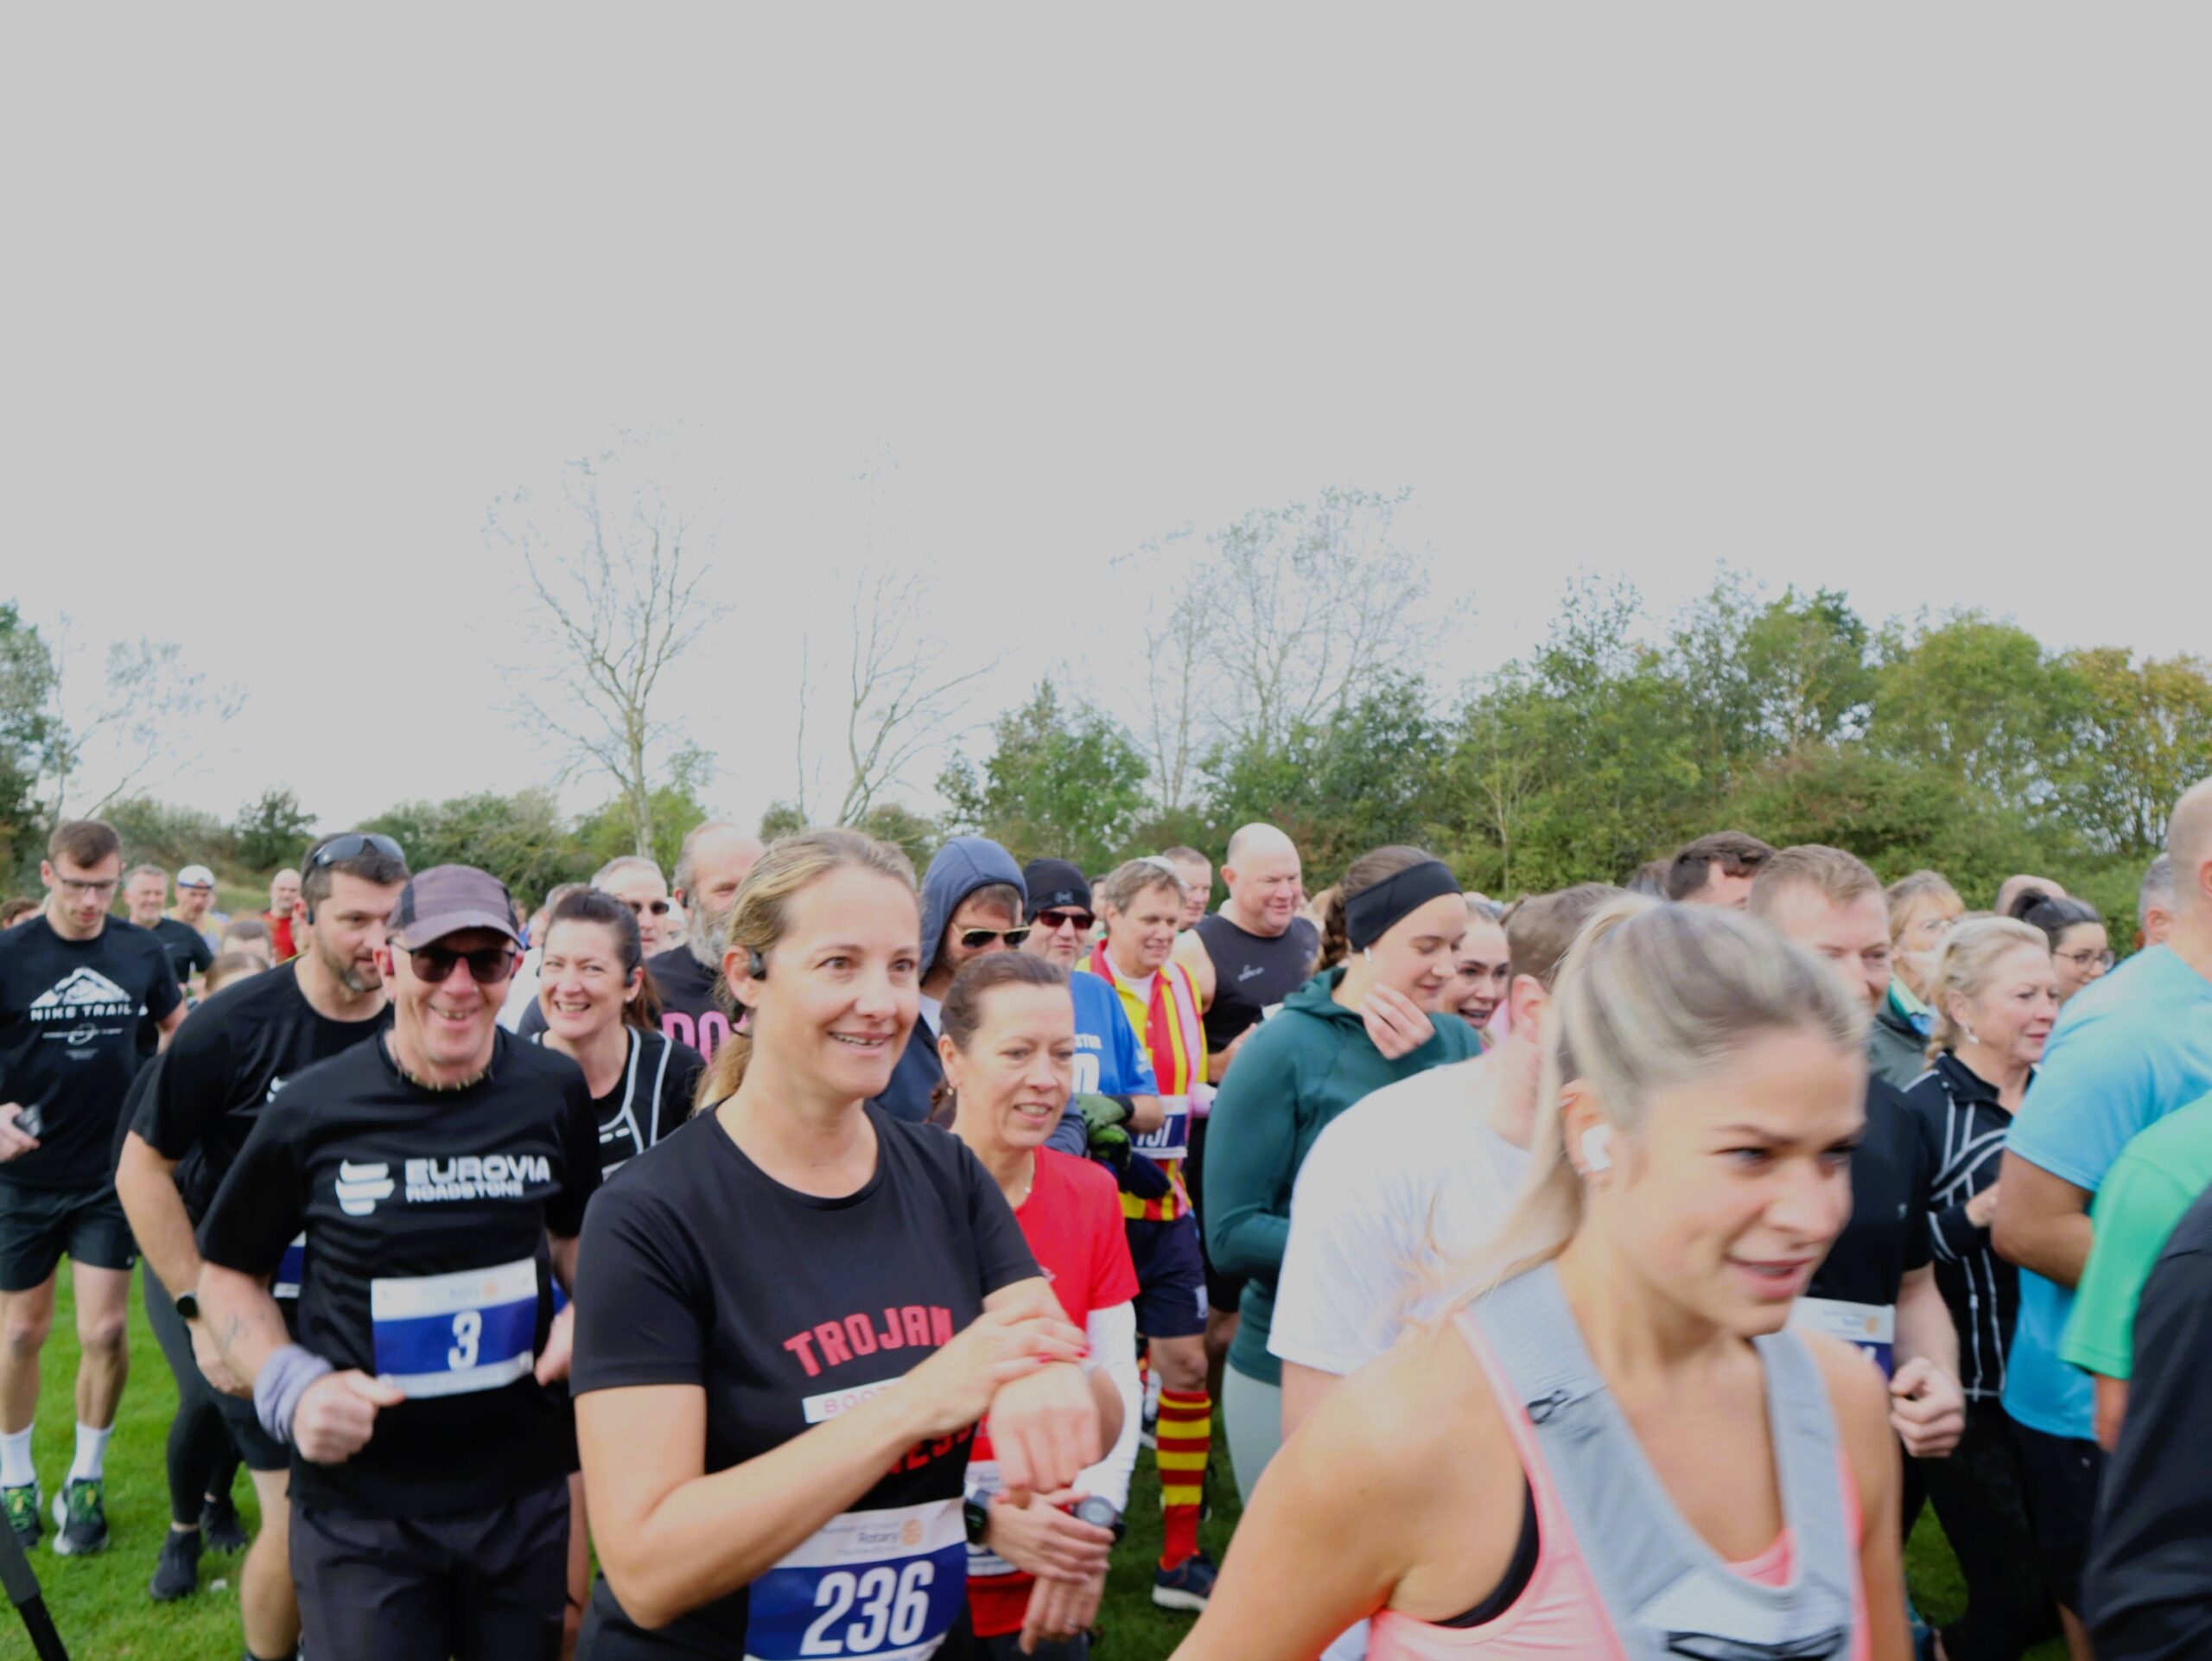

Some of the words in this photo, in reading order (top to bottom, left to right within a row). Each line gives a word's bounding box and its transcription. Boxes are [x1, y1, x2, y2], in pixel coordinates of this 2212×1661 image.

[29, 1006, 77, 1021] NIKE
[82, 1002, 132, 1018] TRAIL
[405, 1155, 551, 1184] EUROVIA
[405, 1181, 524, 1203] ROADSTONE
[448, 1309, 482, 1371] 3
[782, 1304, 955, 1378] TROJAN
[799, 1559, 935, 1656] 236
